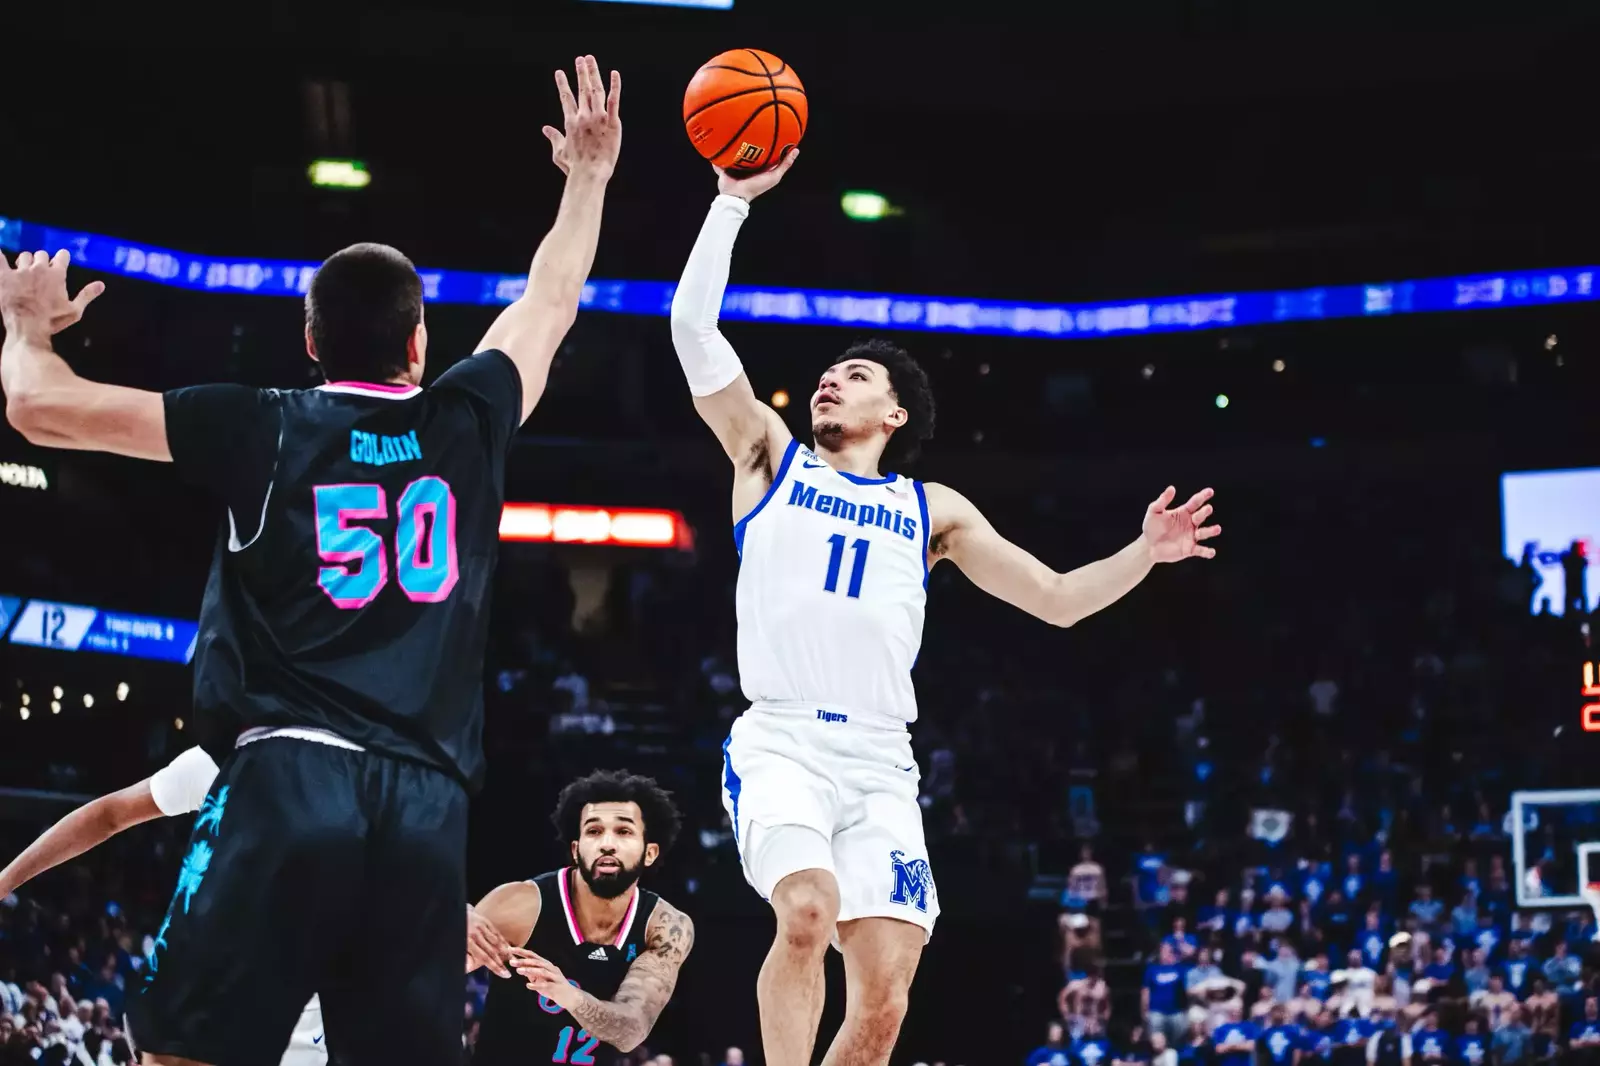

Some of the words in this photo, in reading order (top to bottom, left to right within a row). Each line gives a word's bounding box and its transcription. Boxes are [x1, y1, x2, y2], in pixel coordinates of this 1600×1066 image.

[351, 429, 423, 466] GOLDIN
[786, 479, 917, 541] Memphis
[312, 475, 460, 610] 50
[823, 532, 871, 599] 11
[41, 607, 66, 642] 12
[816, 709, 848, 723] Tigers
[552, 1025, 600, 1066] 12
